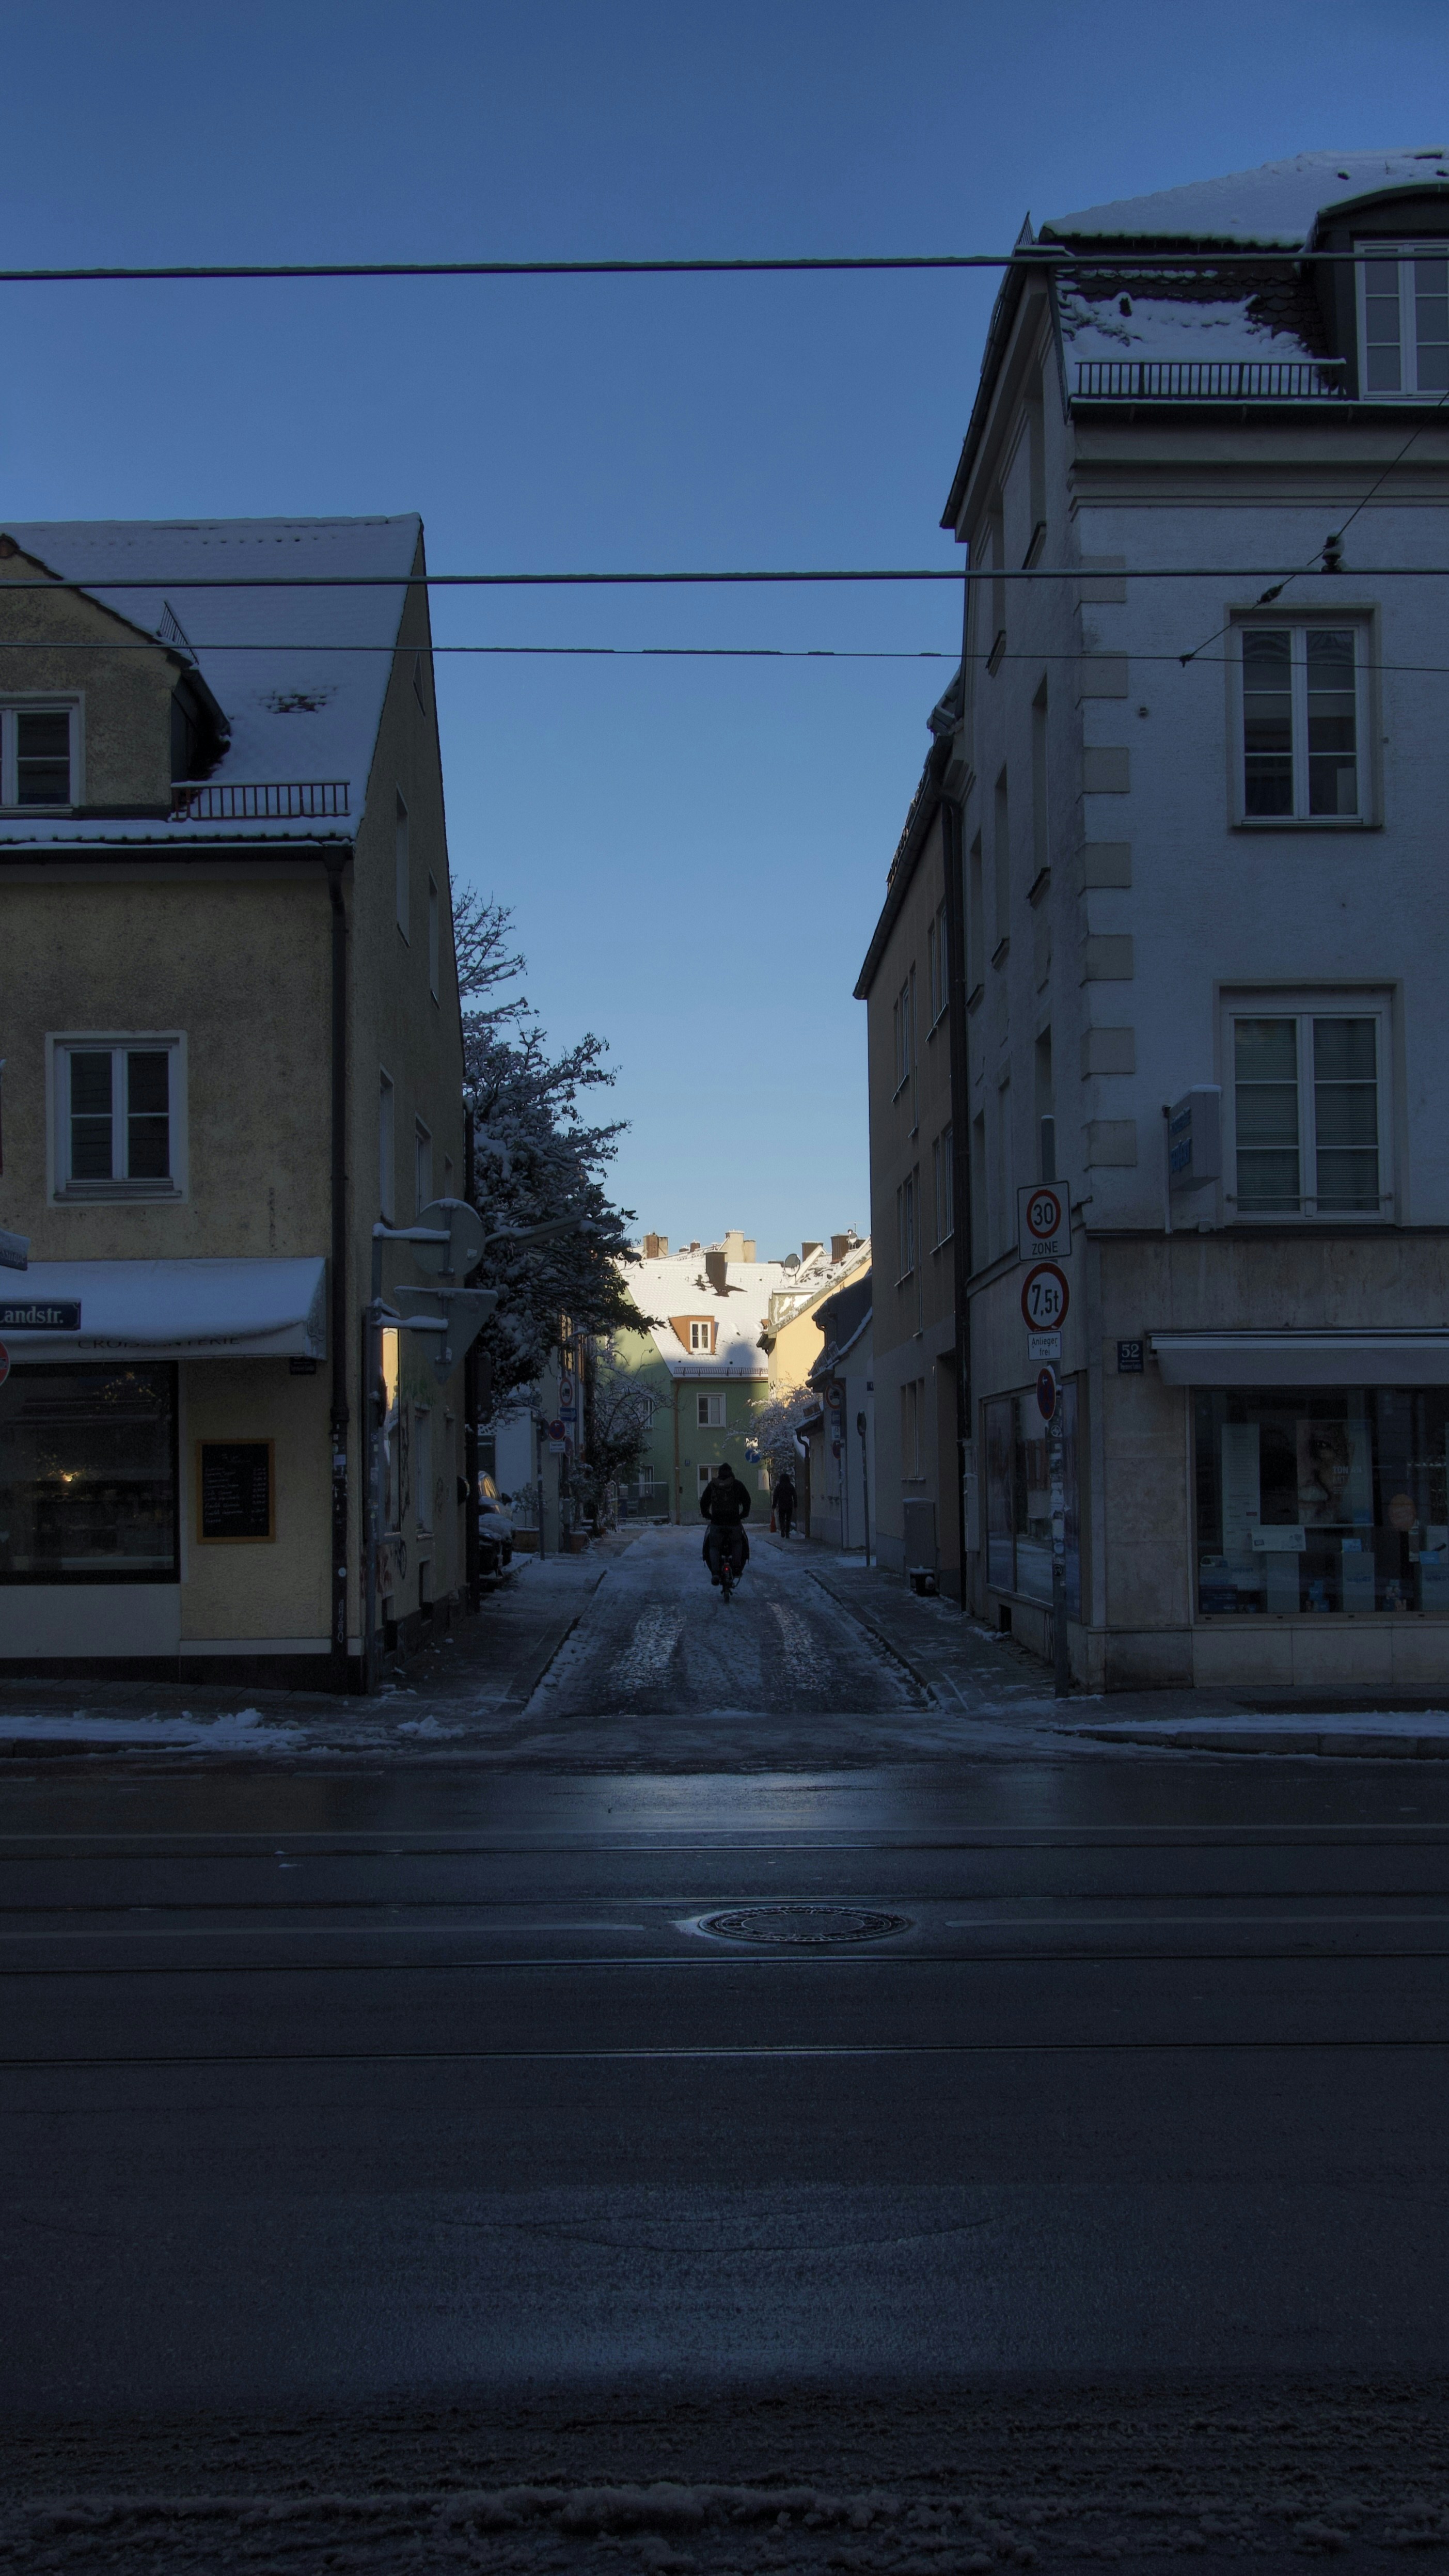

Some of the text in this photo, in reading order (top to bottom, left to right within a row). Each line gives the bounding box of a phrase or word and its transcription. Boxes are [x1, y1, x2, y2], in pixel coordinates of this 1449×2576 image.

[1033, 1202, 1053, 1227] 30
[1032, 1240, 1058, 1255] ZONE
[1032, 1336, 1058, 1348] Anlieger
[1039, 1347, 1050, 1356] frei
[1122, 1344, 1139, 1358] 52
